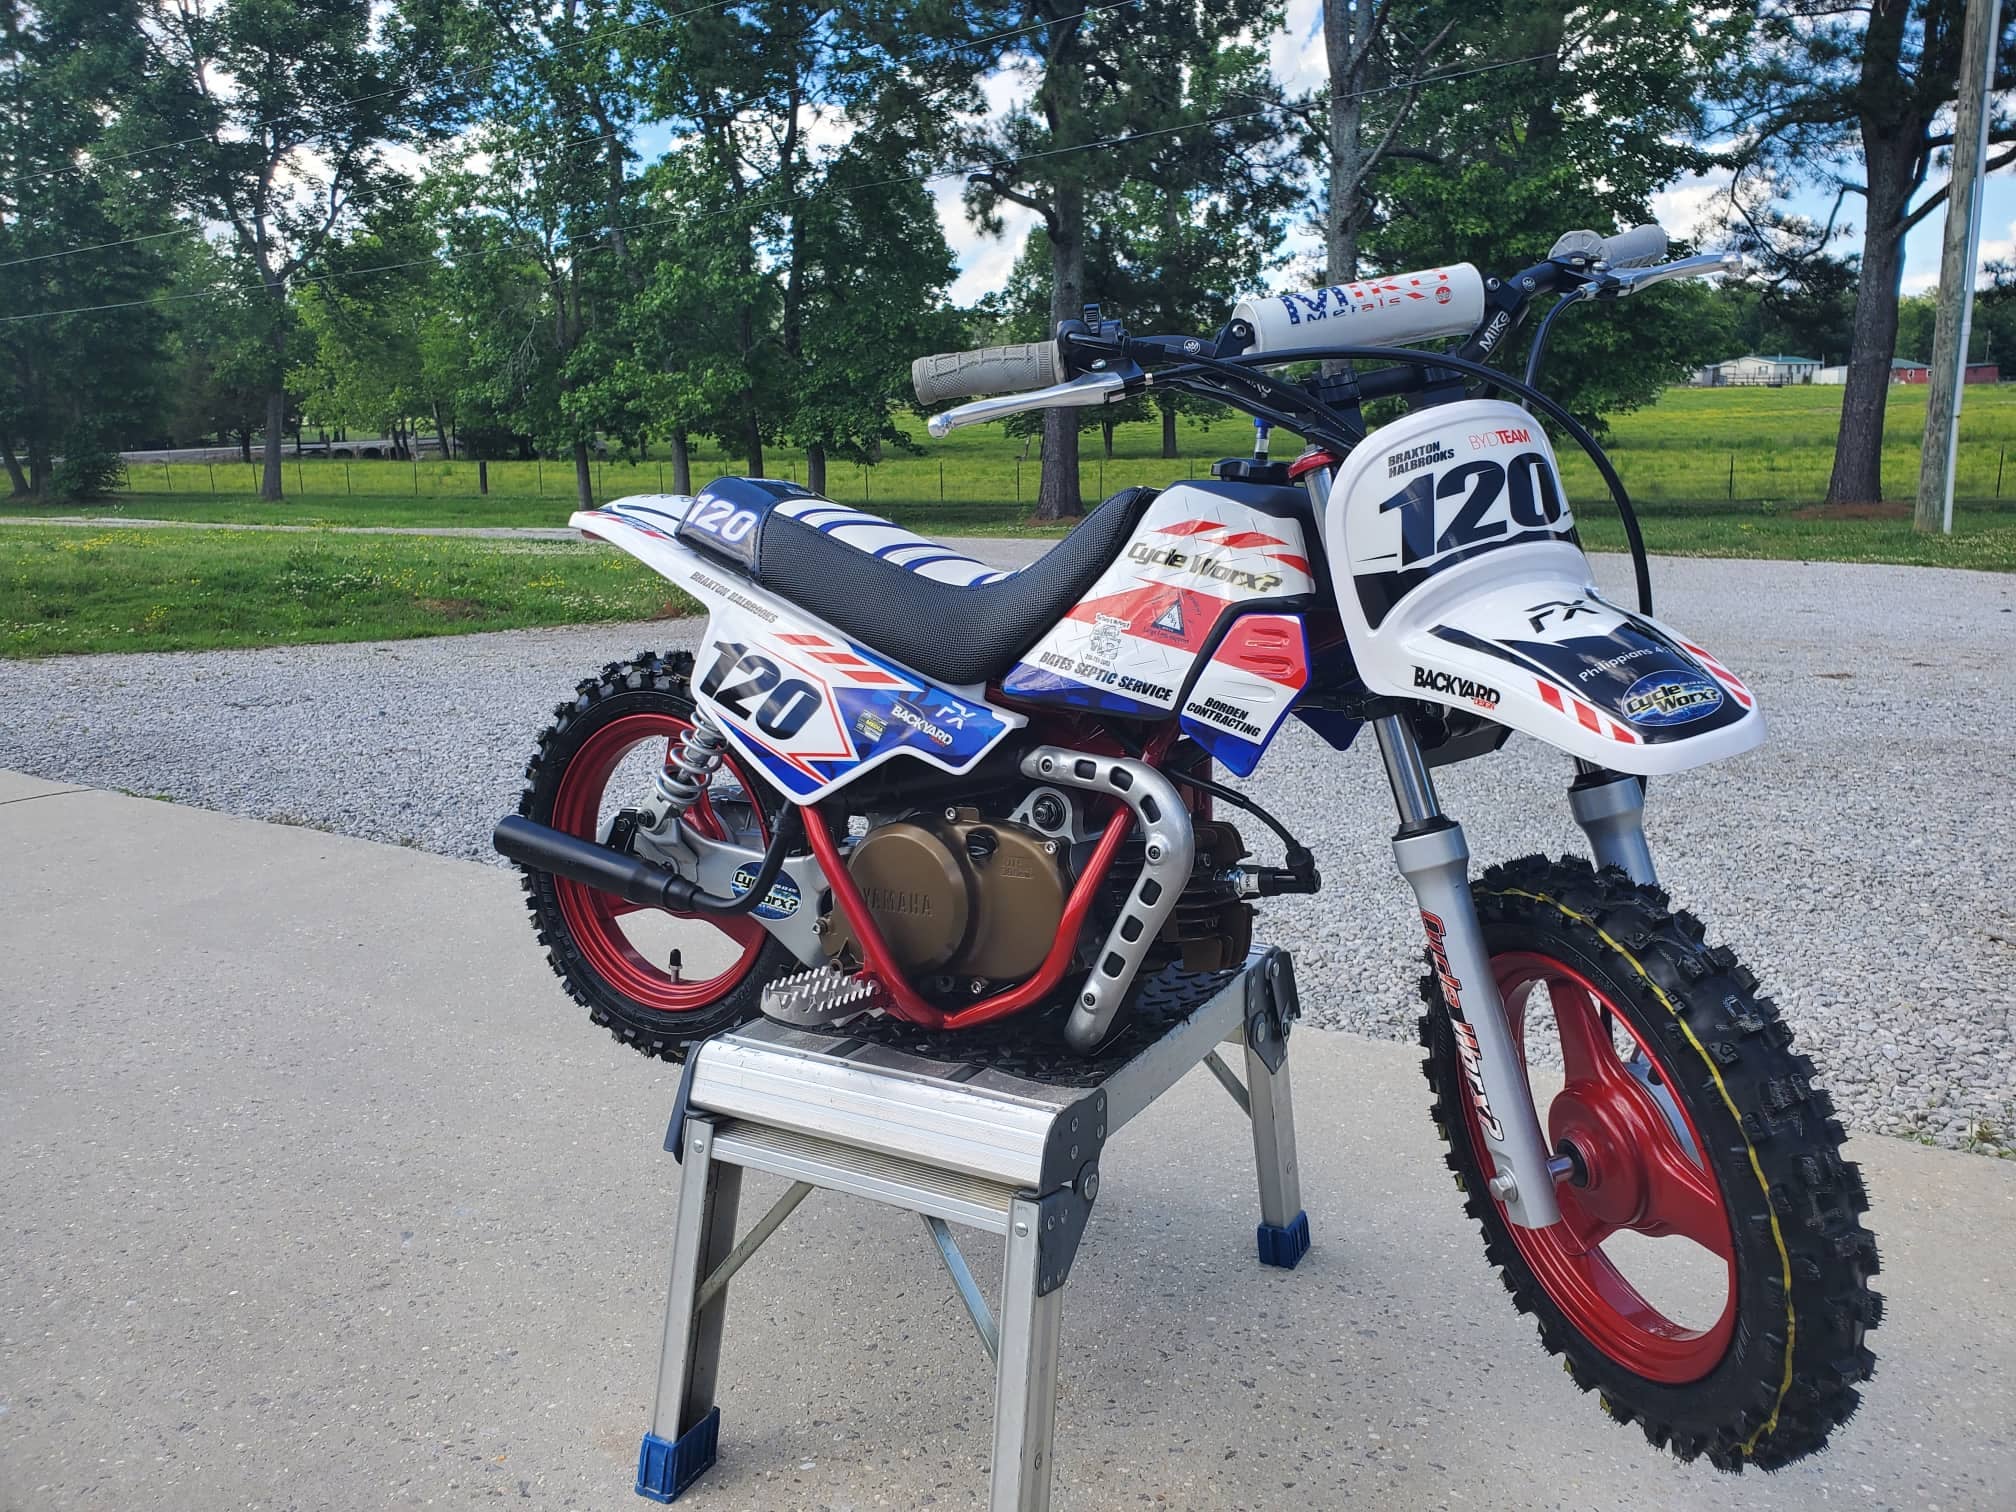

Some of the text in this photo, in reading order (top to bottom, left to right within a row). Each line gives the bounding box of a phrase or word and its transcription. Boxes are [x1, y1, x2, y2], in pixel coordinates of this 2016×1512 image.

[1387, 441, 1441, 467] BRAXTON
[1388, 448, 1456, 478] HALBROOKS
[686, 493, 758, 543] 120
[1379, 452, 1562, 567] 120
[1127, 542, 1283, 593] Cycle Worx?
[690, 571, 778, 623] BRAXTON HALBROOKS
[1040, 651, 1075, 671] BATES
[1074, 662, 1118, 685] SEPTIC
[1117, 675, 1174, 702] SERVICE
[1578, 647, 1654, 682] Philippians
[699, 640, 823, 741] 120
[1411, 665, 1501, 705] BACKYARD
[1627, 685, 1681, 713] Cycle
[1655, 688, 1718, 713] Worx?
[891, 704, 953, 746] BACKYARD
[1186, 702, 1262, 737] CONTRACTING
[1204, 697, 1249, 721] BORDEN
[862, 887, 933, 916] YAMAHA
